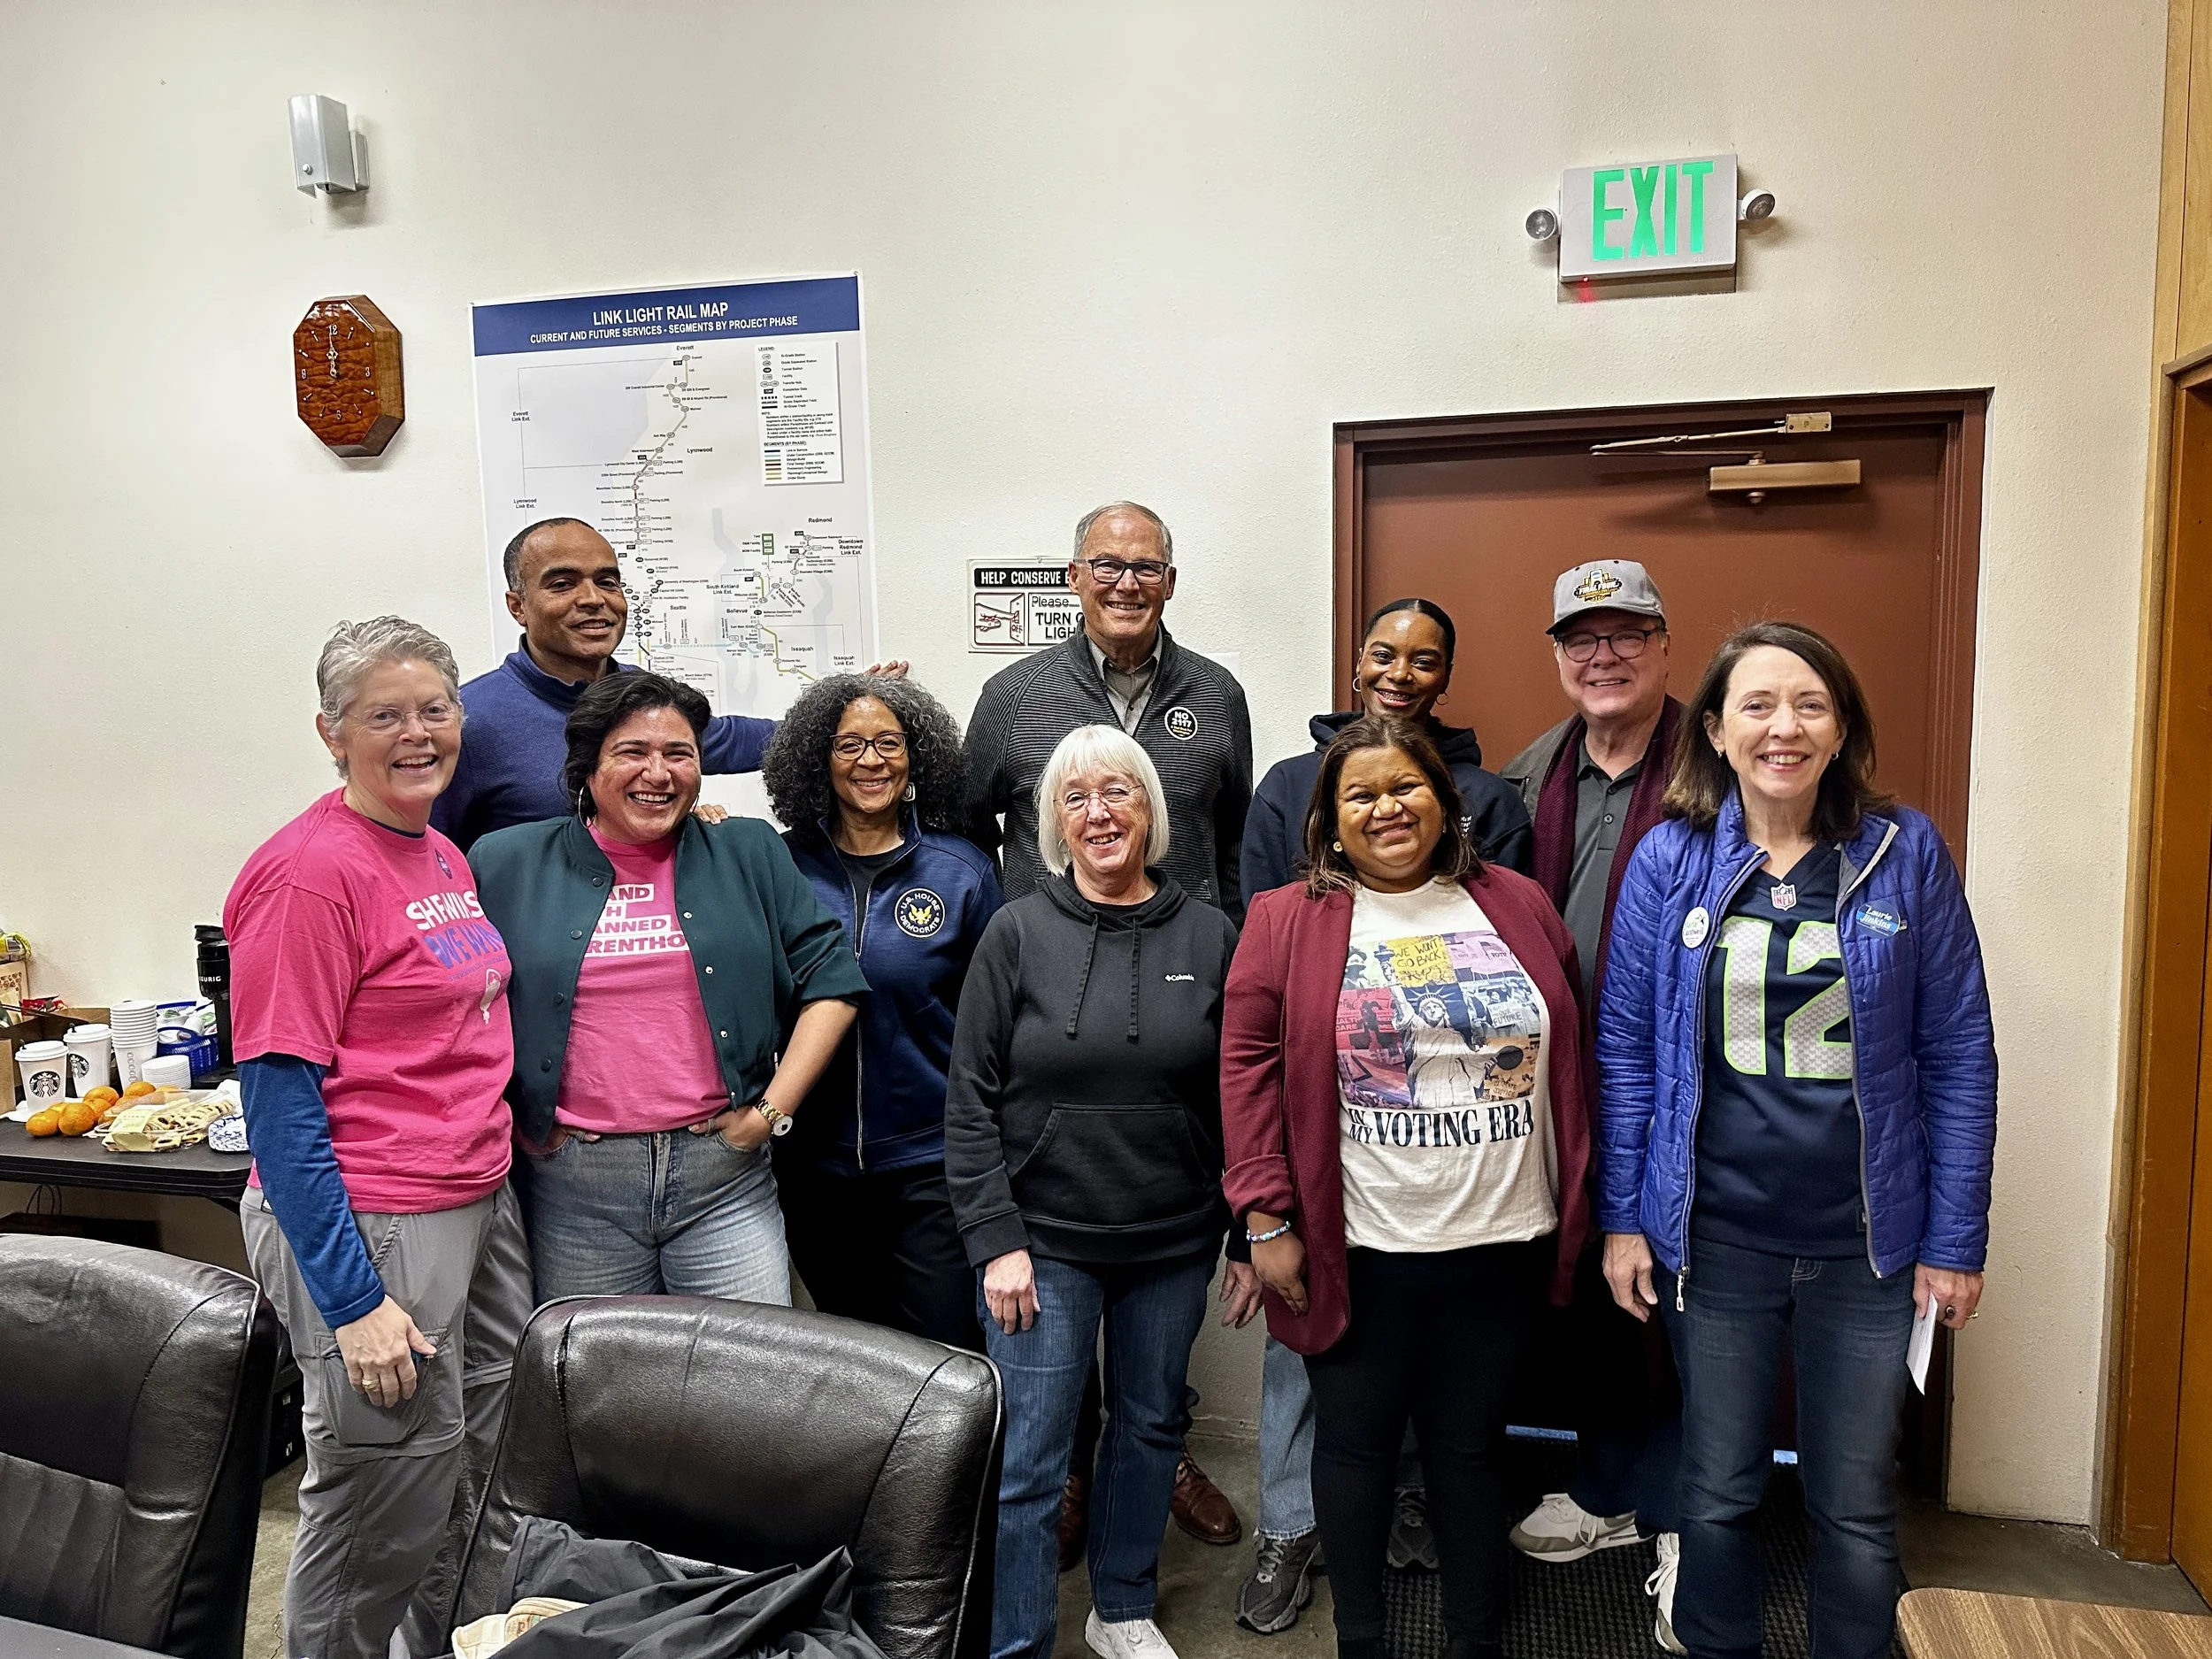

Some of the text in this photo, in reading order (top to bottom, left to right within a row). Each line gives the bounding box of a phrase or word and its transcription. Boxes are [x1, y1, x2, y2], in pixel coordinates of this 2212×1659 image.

[1593, 161, 1714, 261] EXIT
[593, 302, 729, 326] LINK LIGHT RAIL MAP
[328, 325, 338, 335] 12
[530, 331, 568, 343] CURRENT
[570, 330, 587, 342] AND
[588, 327, 620, 340] FUTURE
[622, 326, 662, 338] SERVICES
[669, 322, 713, 334] SEGMENTS
[716, 320, 727, 331] BY
[729, 319, 768, 329] PROJECT
[770, 316, 798, 327] PHASE
[365, 367, 371, 377] 3
[980, 572, 1007, 584] HELP
[1010, 572, 1061, 584] CONSERVE
[1035, 612, 1071, 625] TURN
[1174, 711, 1189, 720] NO
[901, 893, 940, 911] U.S. HOUSE
[1777, 895, 1793, 905] NFL
[1860, 914, 1892, 929] Jinkins
[1866, 907, 1892, 920] Laurie
[900, 915, 940, 933] DEMOCRATS
[1397, 949, 1440, 967] GO BACK
[1715, 916, 1853, 1079] 12
[1493, 1012, 1522, 1026] FUTURE
[1348, 1108, 1366, 1125] IN
[1372, 1099, 1535, 1148] VOTING ERA
[1348, 1124, 1372, 1144] MY
